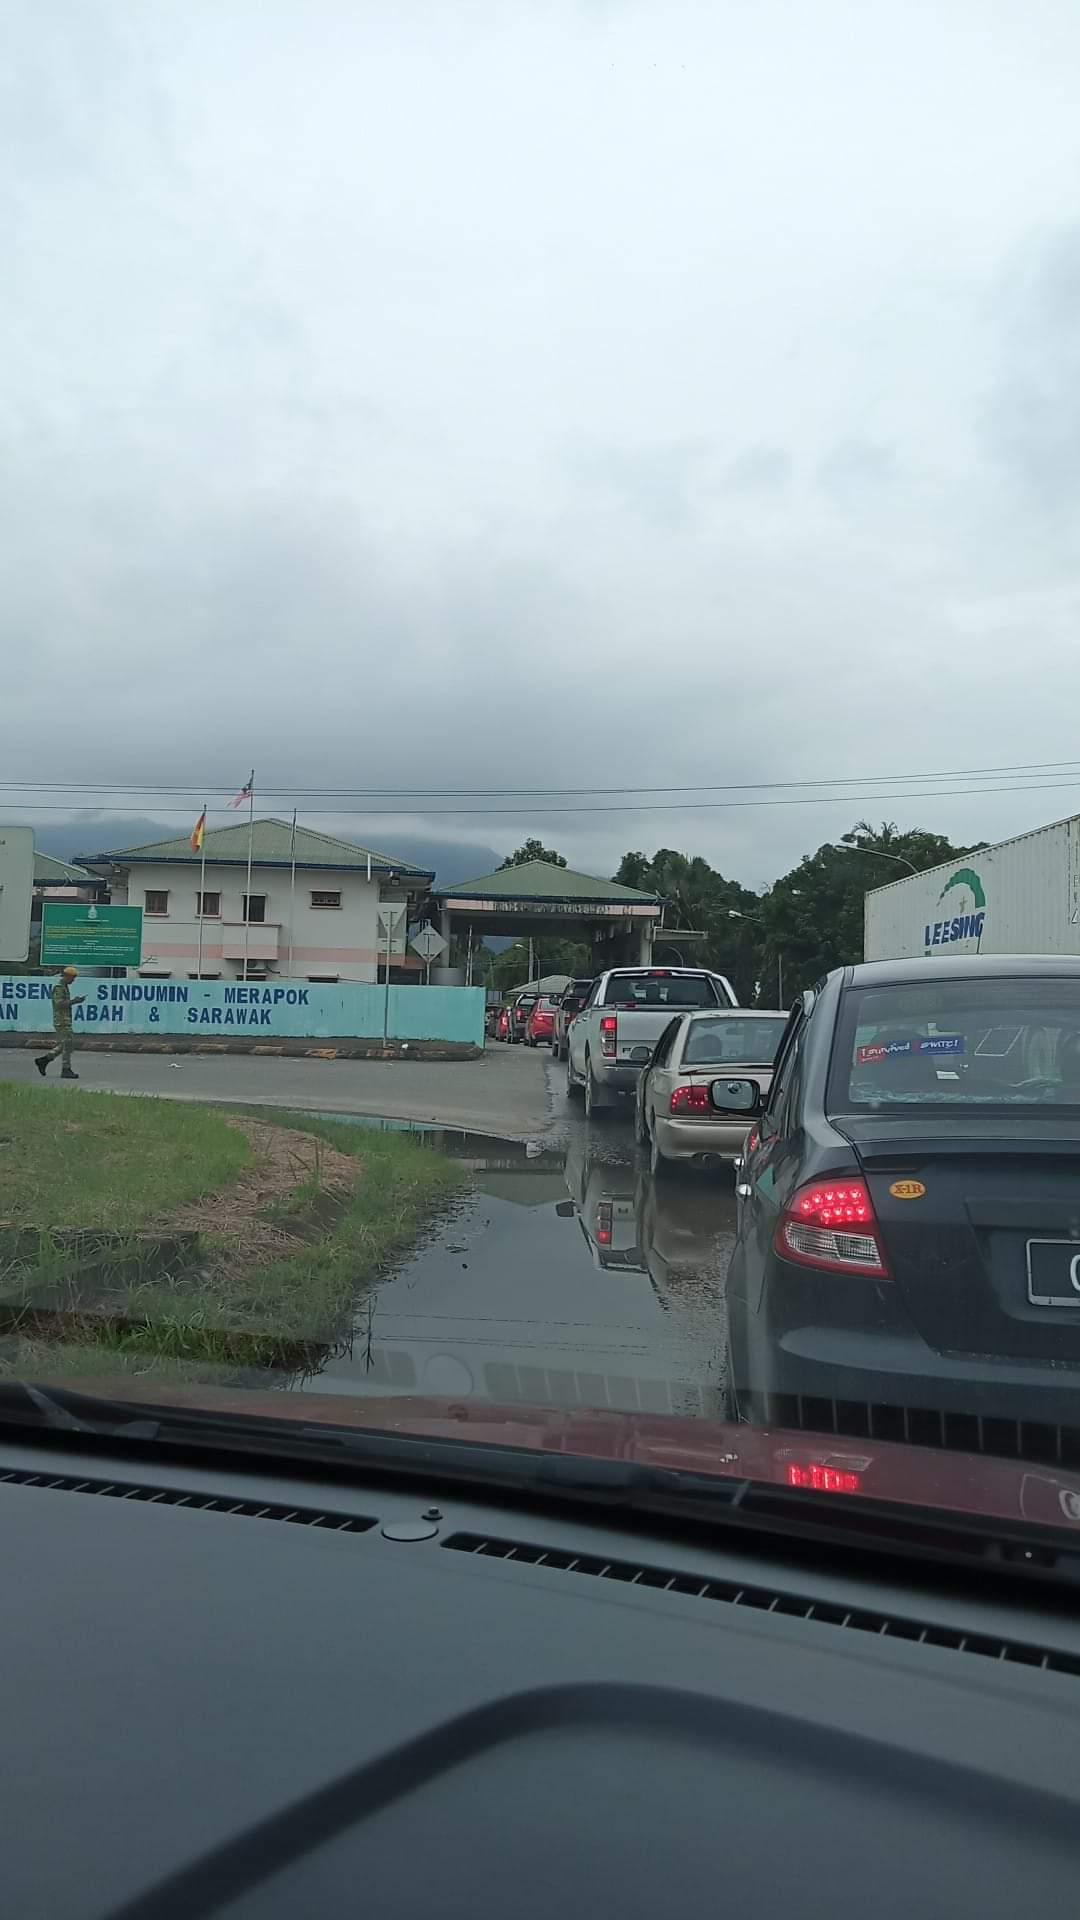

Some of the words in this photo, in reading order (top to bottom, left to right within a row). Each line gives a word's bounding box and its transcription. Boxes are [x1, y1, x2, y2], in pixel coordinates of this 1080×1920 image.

[97, 984, 188, 1003] SINDUMIN
[224, 987, 309, 1006] MERAPOK
[74, 1004, 123, 1022] ABAH
[149, 1006, 160, 1022] &
[187, 1007, 272, 1025] SARAWAK
[893, 1183, 923, 1194] X-1R
